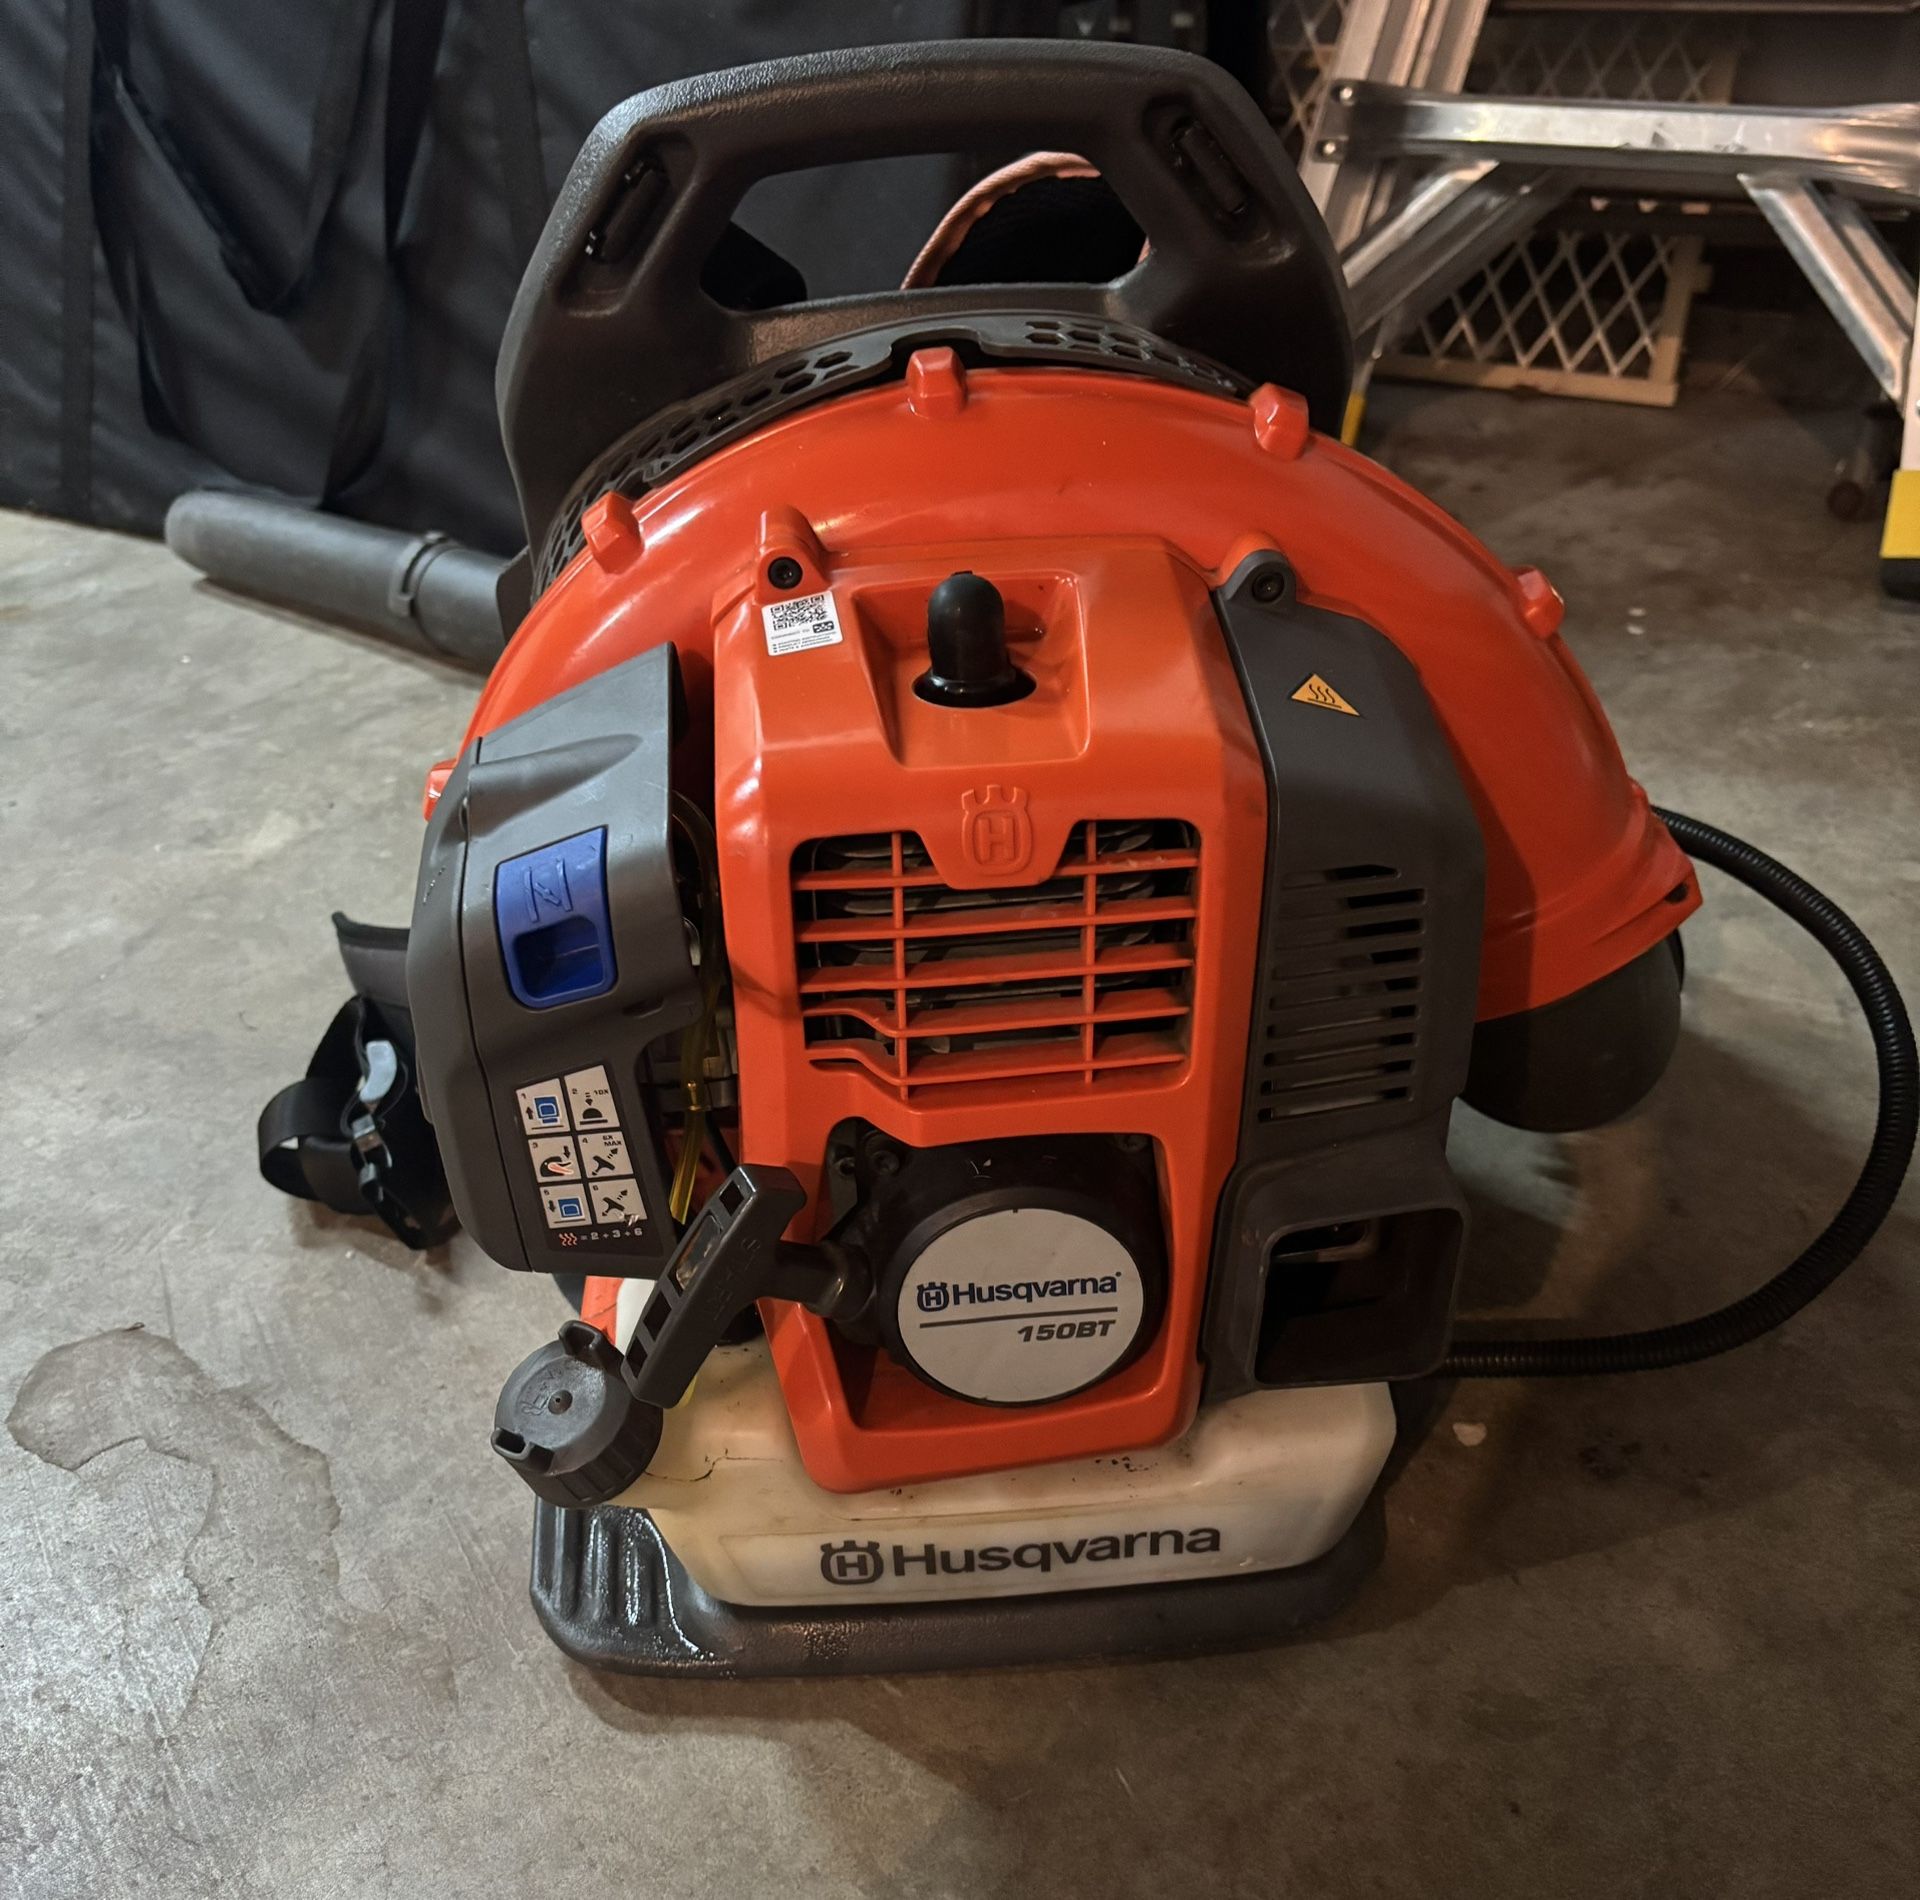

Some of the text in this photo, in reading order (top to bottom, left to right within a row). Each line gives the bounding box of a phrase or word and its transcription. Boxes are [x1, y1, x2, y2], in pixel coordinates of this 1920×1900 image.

[590, 1231, 600, 1241] 2
[612, 1229, 621, 1239] 3
[633, 1227, 643, 1237] 6
[953, 1275, 1118, 1306] Husqvarna
[1017, 1319, 1117, 1343] 150BT
[892, 1526, 1221, 1577] Husqvarna
